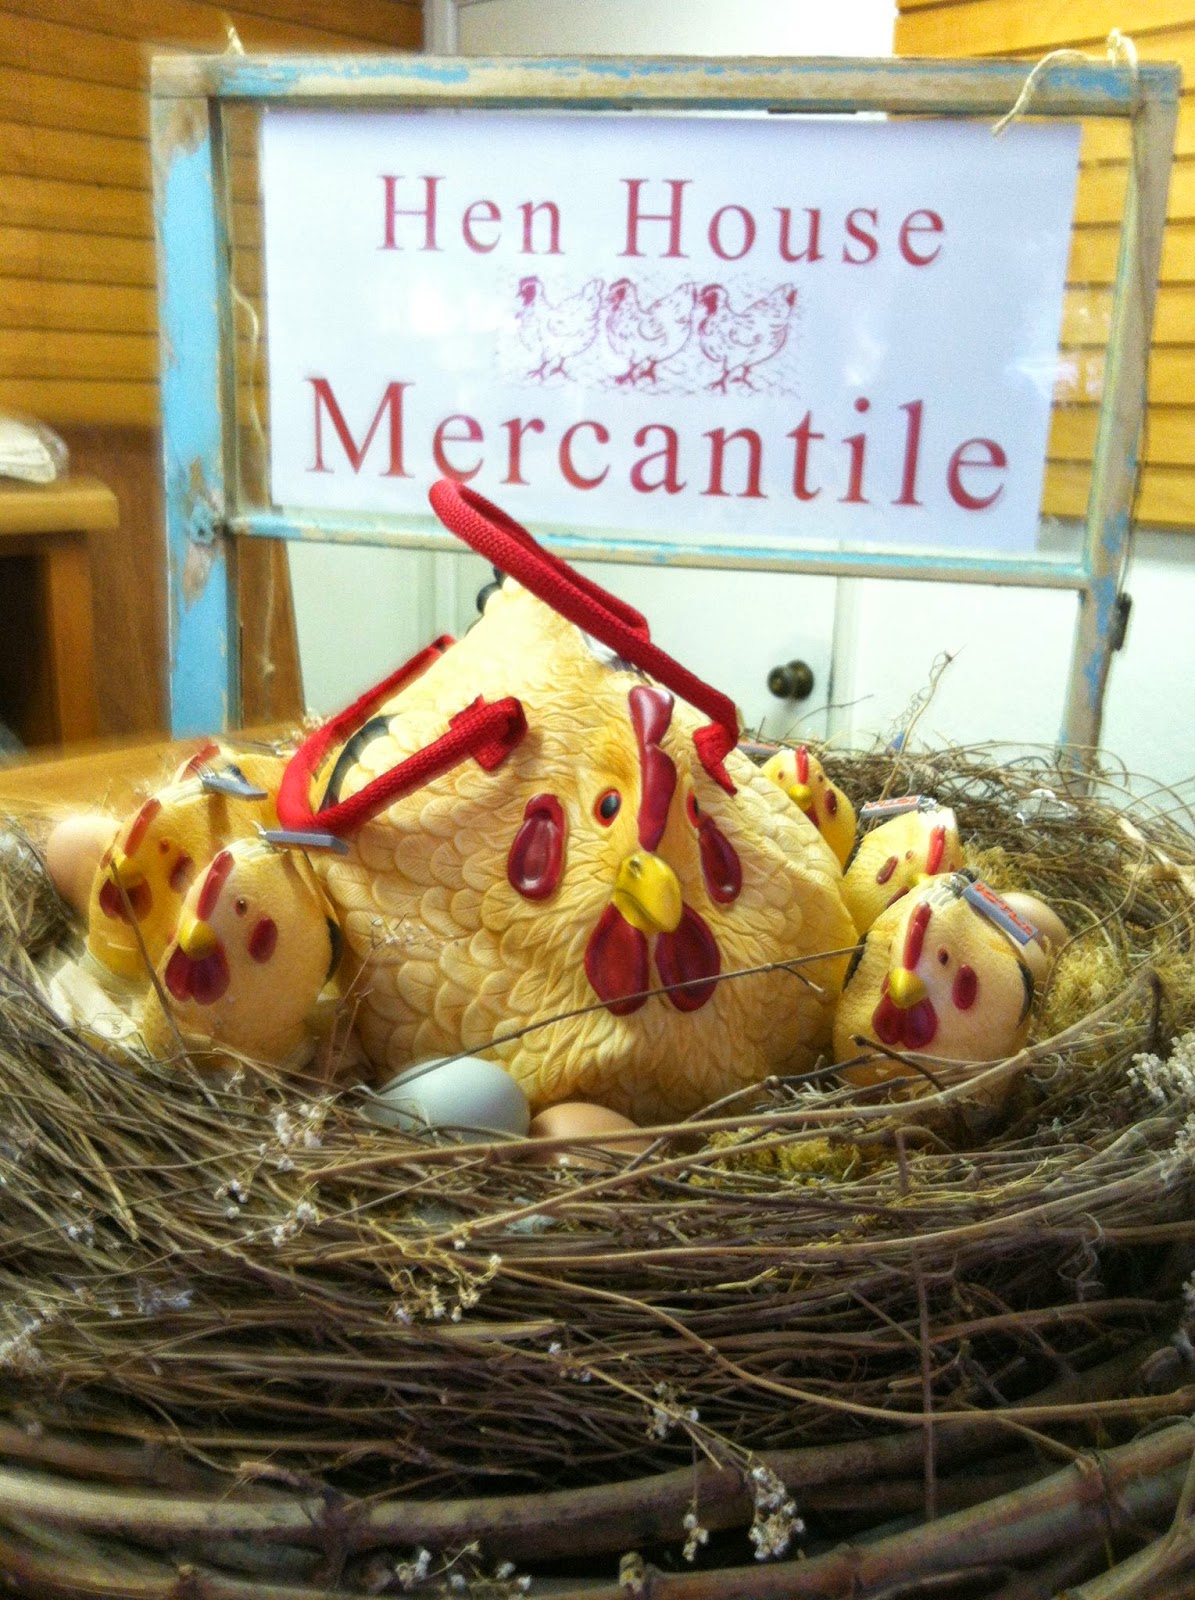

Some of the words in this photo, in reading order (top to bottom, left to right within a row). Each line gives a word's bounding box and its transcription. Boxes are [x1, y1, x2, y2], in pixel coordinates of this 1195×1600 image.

[376, 174, 566, 256] Hen
[617, 178, 945, 267] House
[306, 377, 1007, 511] Mercantile
